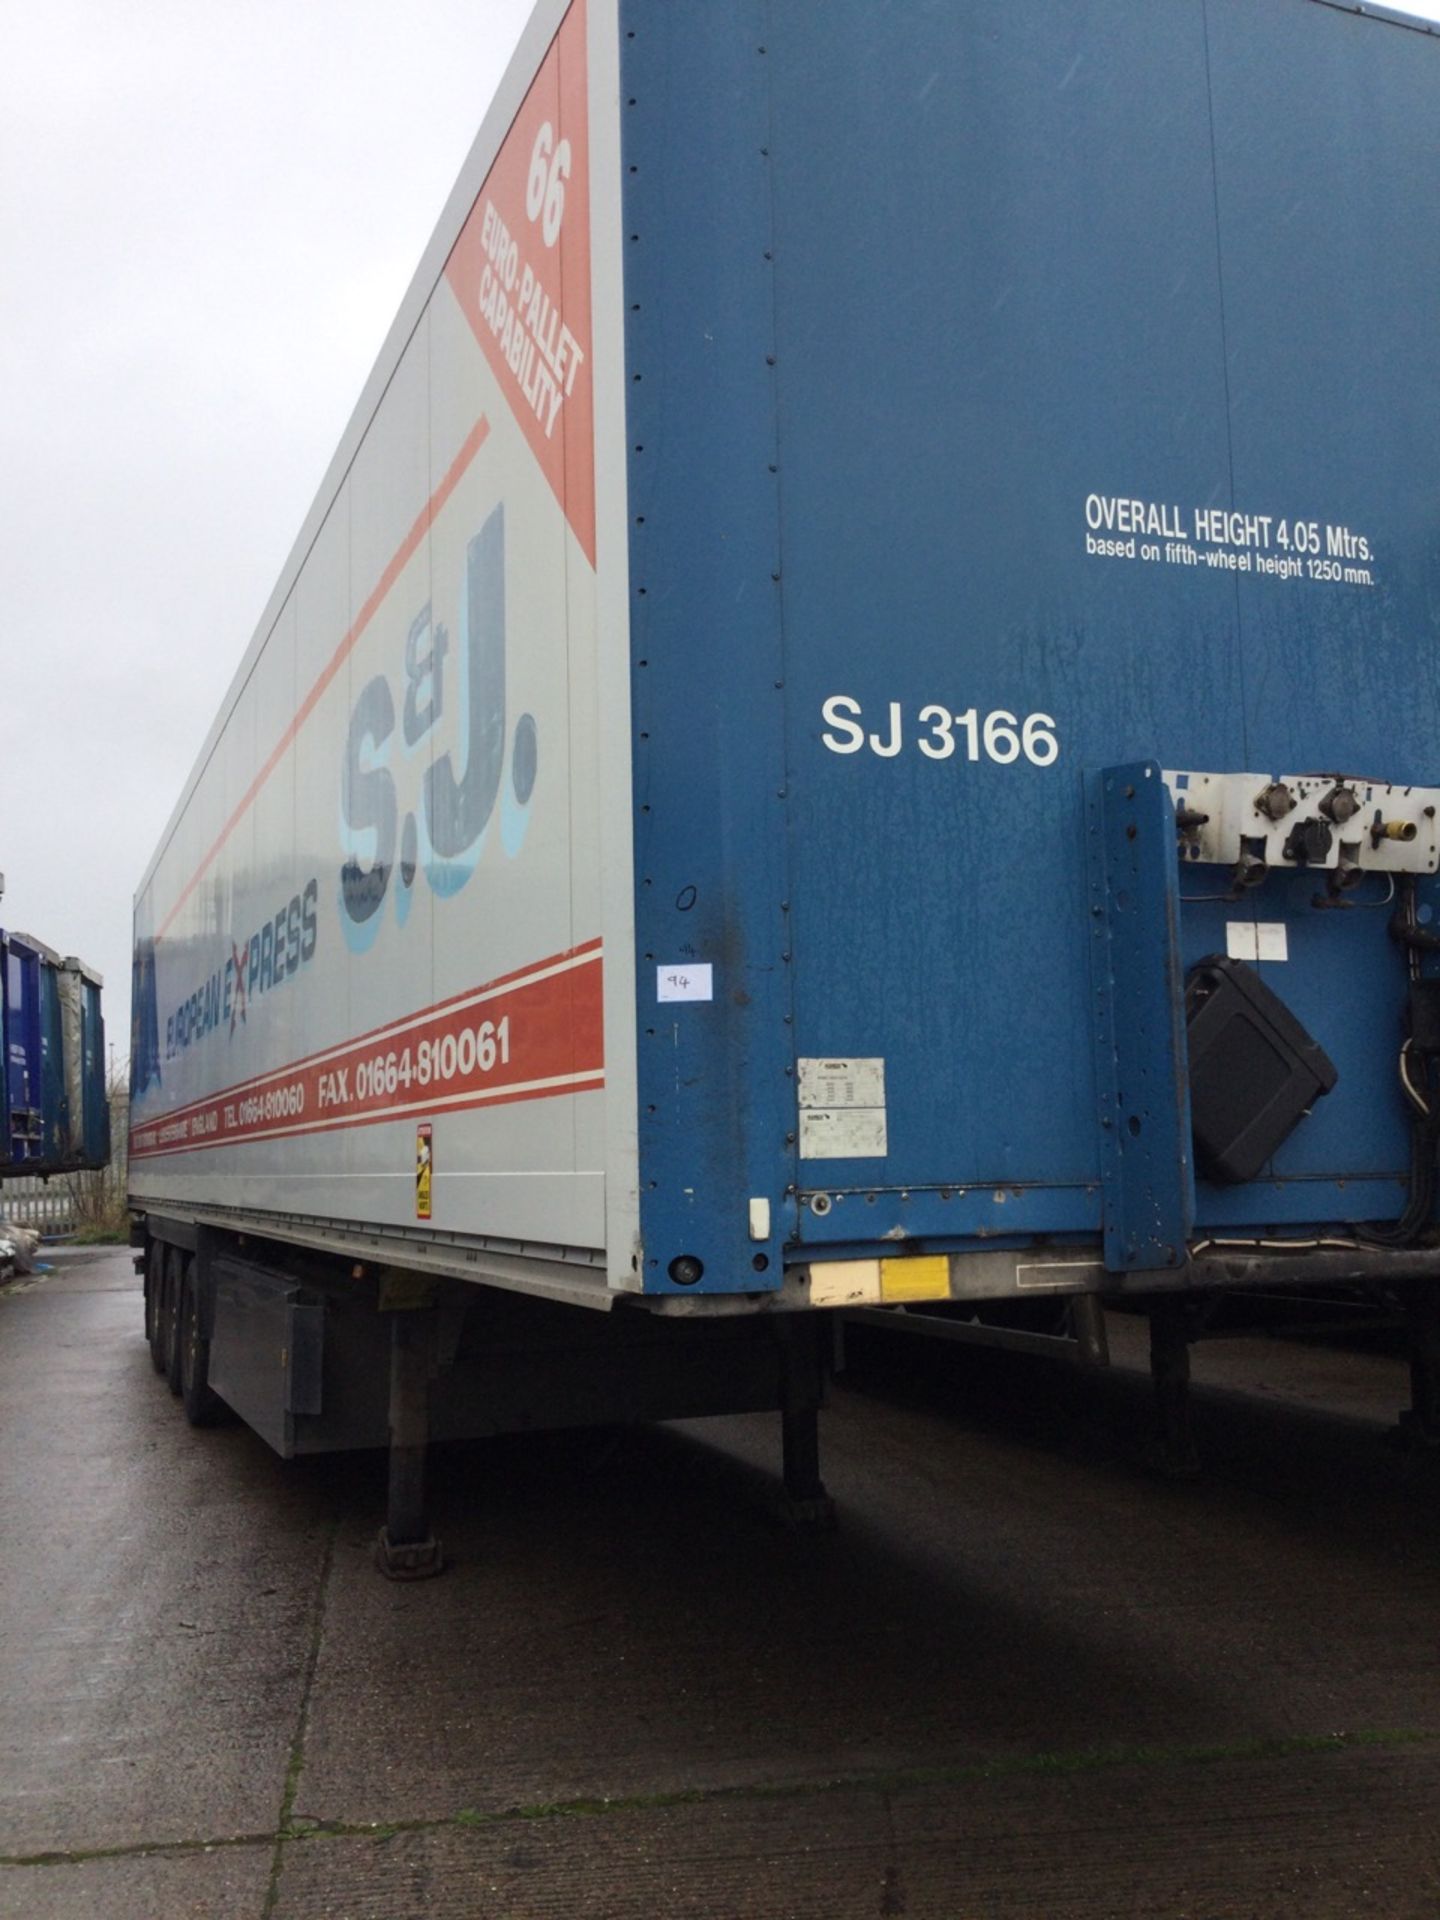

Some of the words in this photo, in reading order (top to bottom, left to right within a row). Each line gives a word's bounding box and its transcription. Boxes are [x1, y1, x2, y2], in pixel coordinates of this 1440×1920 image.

[526, 121, 571, 247] 66
[479, 264, 563, 438] CAPABILITY
[1085, 493, 1187, 539] OVERALL
[1195, 508, 1272, 548] HEIGHT
[1277, 519, 1320, 554] 4.05
[1326, 525, 1374, 562] Mtrs.
[1086, 532, 1135, 559] based
[1141, 544, 1160, 562] on
[1165, 542, 1251, 572] fifth-wheel
[1256, 556, 1302, 580] height
[1307, 559, 1342, 582] 1250
[1344, 566, 1375, 586] mm.
[917, 705, 1059, 767] 3166
[223, 877, 318, 1043] EXPRESS
[667, 975, 690, 989] 94
[318, 1067, 354, 1109] FAX.
